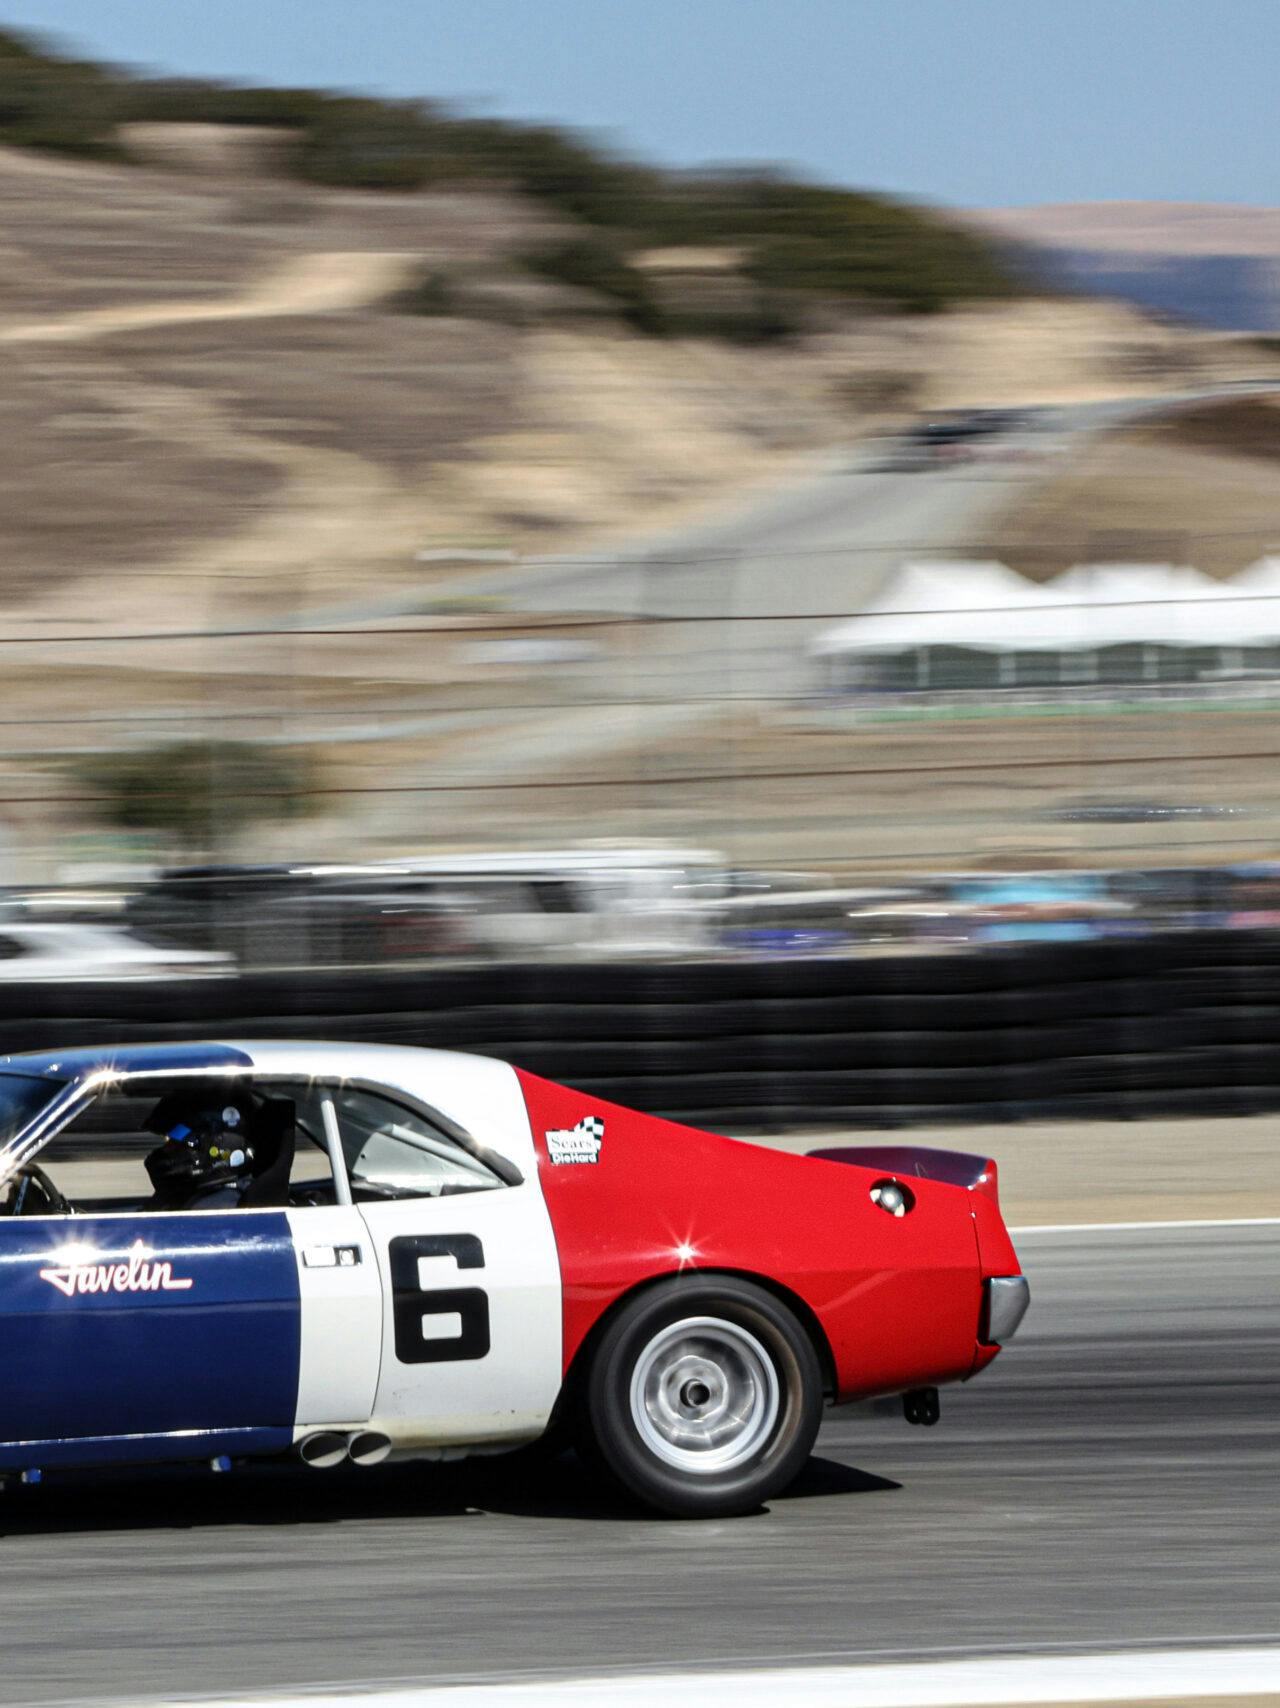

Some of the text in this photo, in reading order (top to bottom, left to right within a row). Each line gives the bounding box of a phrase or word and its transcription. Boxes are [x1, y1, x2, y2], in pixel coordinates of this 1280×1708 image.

[551, 1135, 593, 1150] Sears
[40, 1239, 194, 1297] Javelin
[388, 1233, 491, 1365] 6
